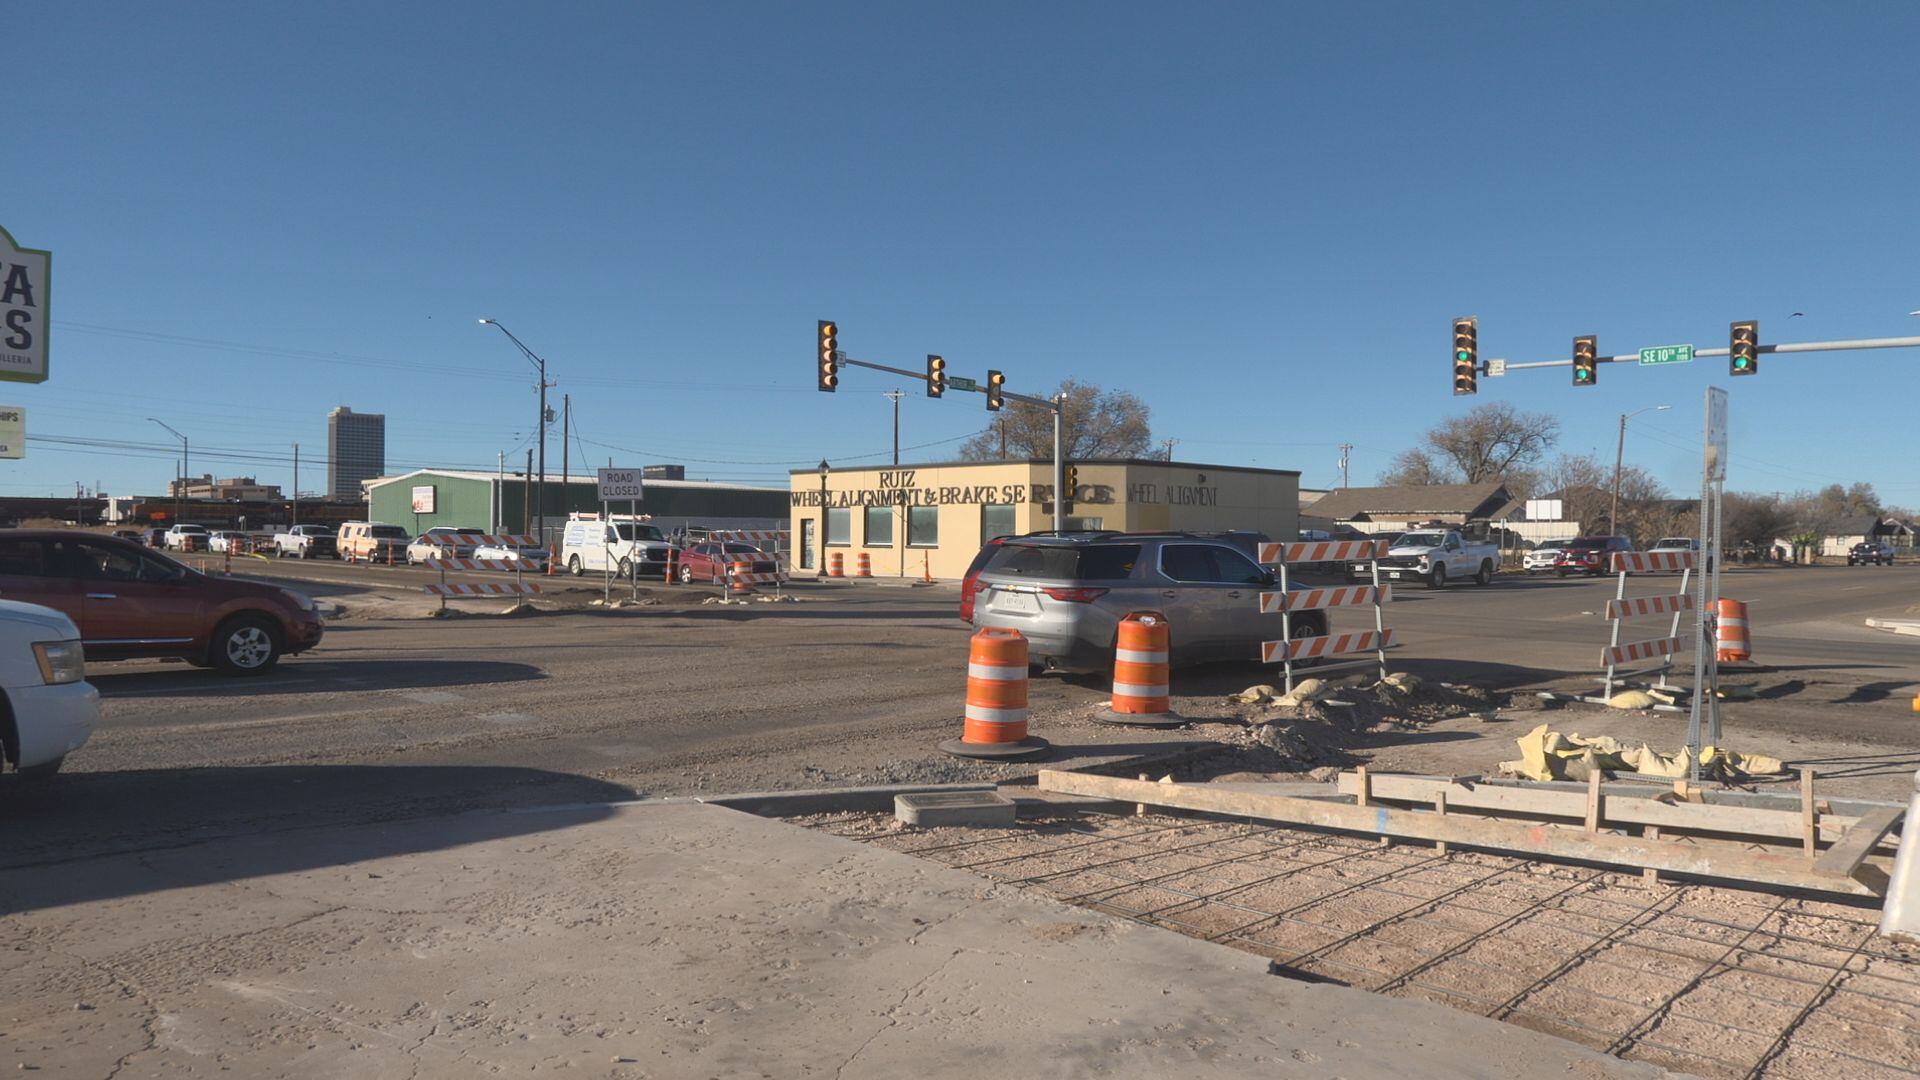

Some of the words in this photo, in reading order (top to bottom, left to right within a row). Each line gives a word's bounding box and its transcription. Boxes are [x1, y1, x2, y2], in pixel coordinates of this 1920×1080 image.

[0, 262, 37, 308] A
[0, 309, 32, 350] S
[1643, 350, 1655, 362] SE
[607, 473, 634, 483] ROAD
[879, 470, 915, 488] RUIZ
[602, 486, 639, 496] CLOSED
[791, 490, 838, 507] WHEEL
[839, 488, 922, 507] ALIGNMENT
[924, 487, 938, 506] &
[939, 485, 997, 505] BRAKE
[1002, 484, 1116, 505] SERCE
